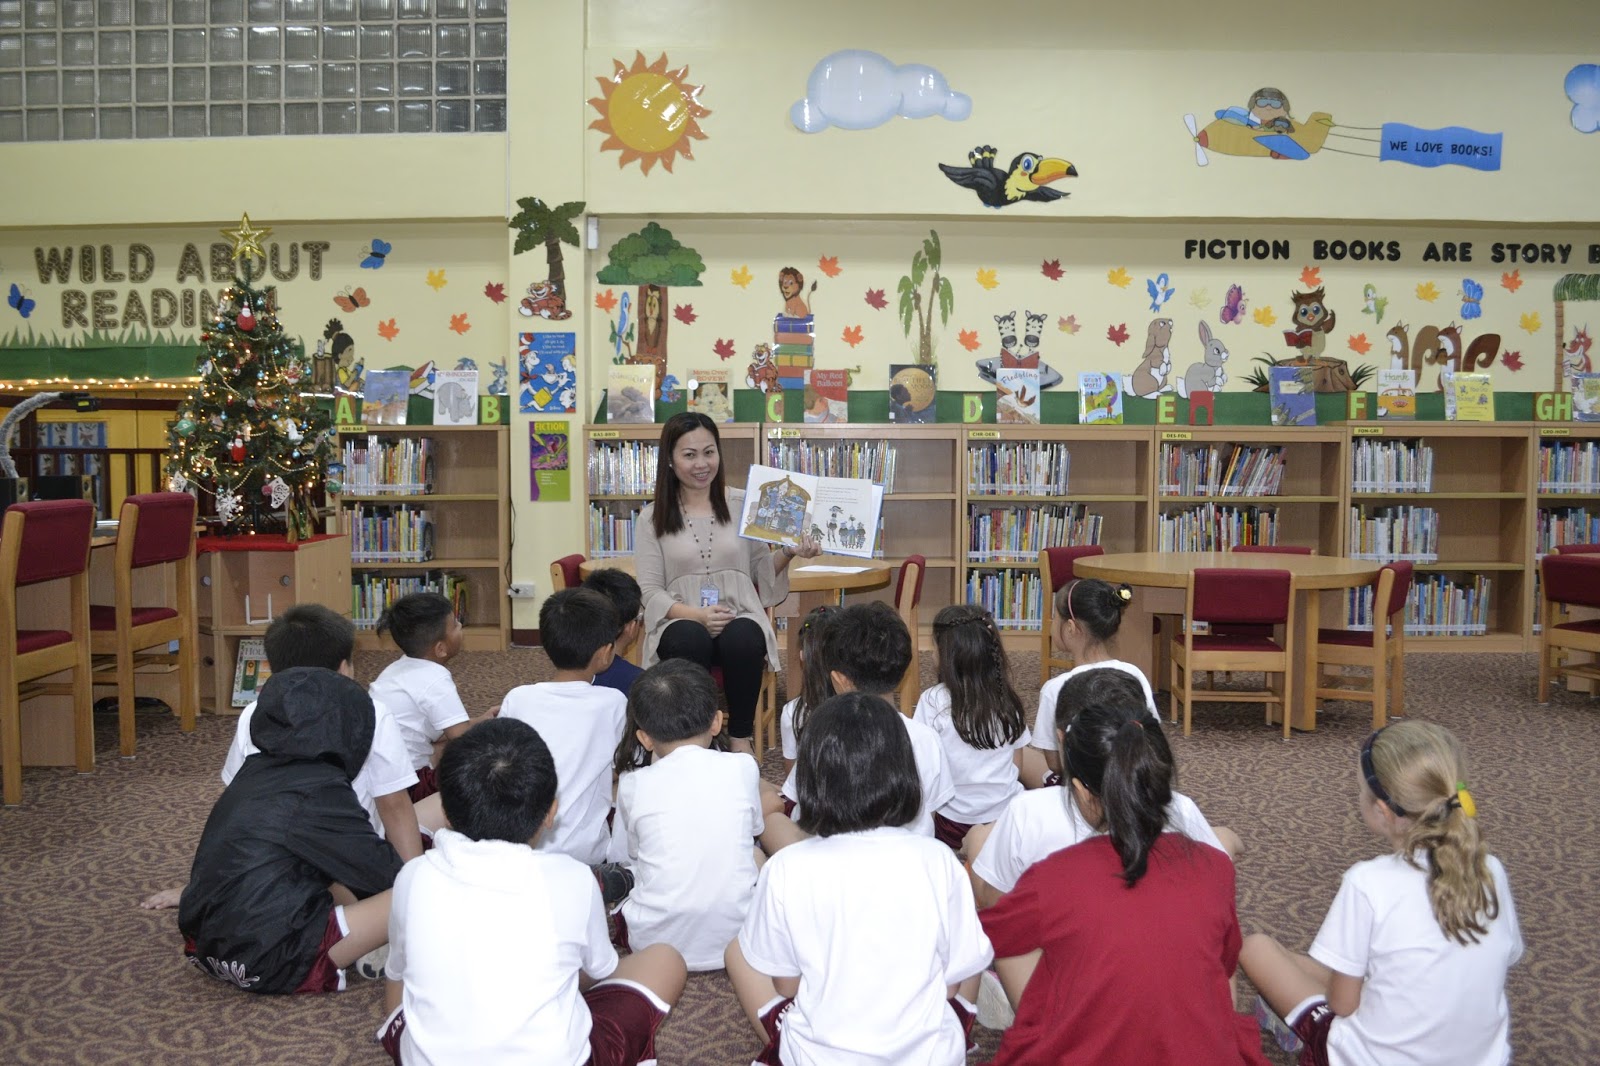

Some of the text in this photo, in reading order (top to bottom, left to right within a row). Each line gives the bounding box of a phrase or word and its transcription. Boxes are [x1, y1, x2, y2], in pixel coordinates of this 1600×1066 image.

[1390, 141, 1493, 157] WE LOVE BOOKS!
[34, 241, 331, 284] WILD ABOUT
[1185, 239, 1290, 260] FICTION
[1313, 239, 1401, 261] BOOKS
[1422, 241, 1472, 262] ARE
[1491, 242, 1572, 264] STORY
[816, 372, 828, 380] My
[816, 379, 843, 387] Balloon
[1001, 370, 1039, 385] Fledgling
[1384, 372, 1410, 382] Hank
[335, 396, 354, 424] A
[481, 396, 500, 424] B
[767, 394, 782, 422] C
[963, 394, 982, 423] D
[1159, 396, 1175, 423] E
[1350, 393, 1366, 420] F
[1536, 393, 1572, 421] GH
[535, 422, 565, 431] FICTION
